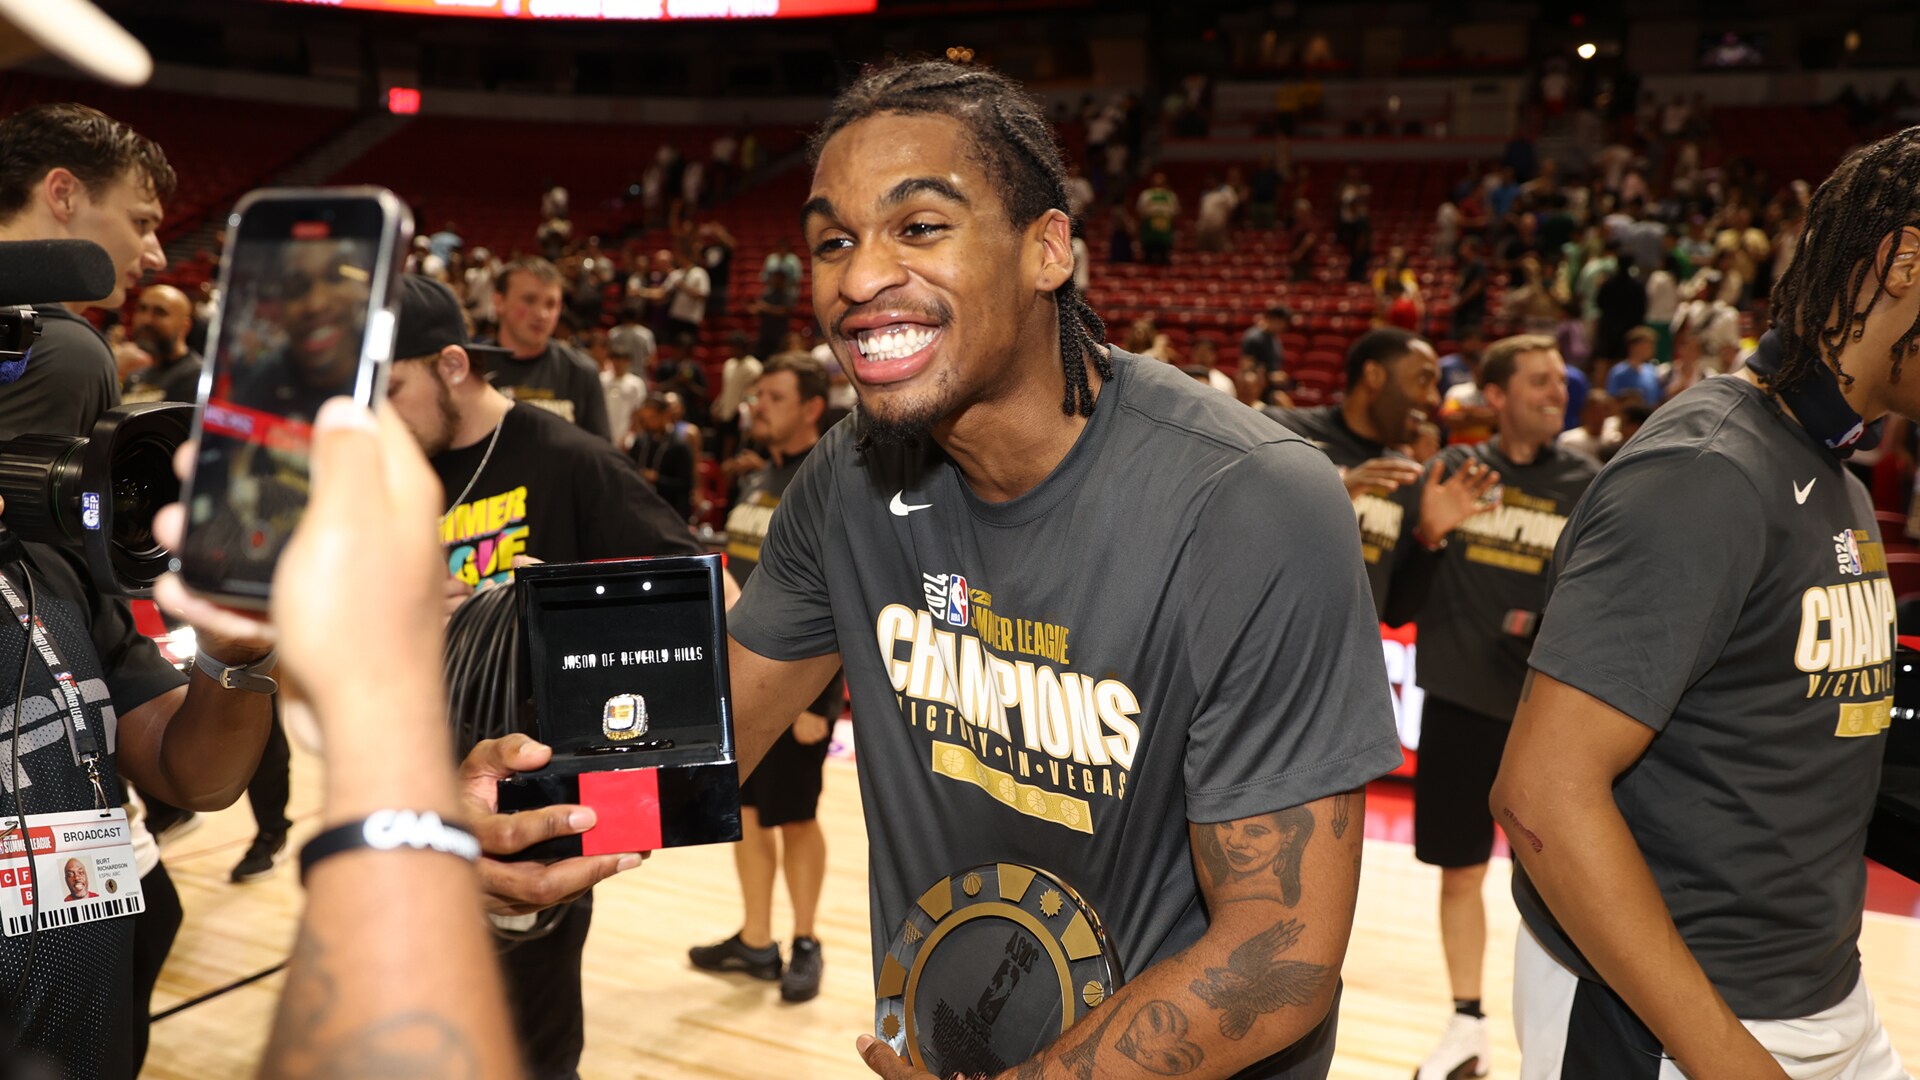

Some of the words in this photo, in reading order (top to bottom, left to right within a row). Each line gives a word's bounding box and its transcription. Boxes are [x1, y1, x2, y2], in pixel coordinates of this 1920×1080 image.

[90, 495, 99, 519] NEP
[1832, 532, 1853, 575] 2024
[2, 588, 25, 609] LEAGUE
[922, 572, 950, 621] 2024
[1794, 578, 1898, 672] CHAMP
[1016, 618, 1070, 665] LEAGUE
[38, 644, 61, 667] LEAGUE
[562, 654, 597, 670] JASON
[601, 652, 616, 668] OF
[620, 648, 669, 666] BEVERLY
[674, 646, 703, 662] HILLS
[59, 679, 80, 708] SUMMER
[70, 706, 87, 732] LEAGUE
[1049, 759, 1128, 801] VEGAS
[3, 838, 27, 854] SUMME
[30, 836, 52, 851] LEAGUE
[63, 827, 121, 843] BROADCAST
[96, 857, 111, 866] BURT
[97, 862, 128, 872] RICHARDSON
[3, 873, 12, 884] C
[22, 870, 29, 881] F
[25, 890, 33, 901] B
